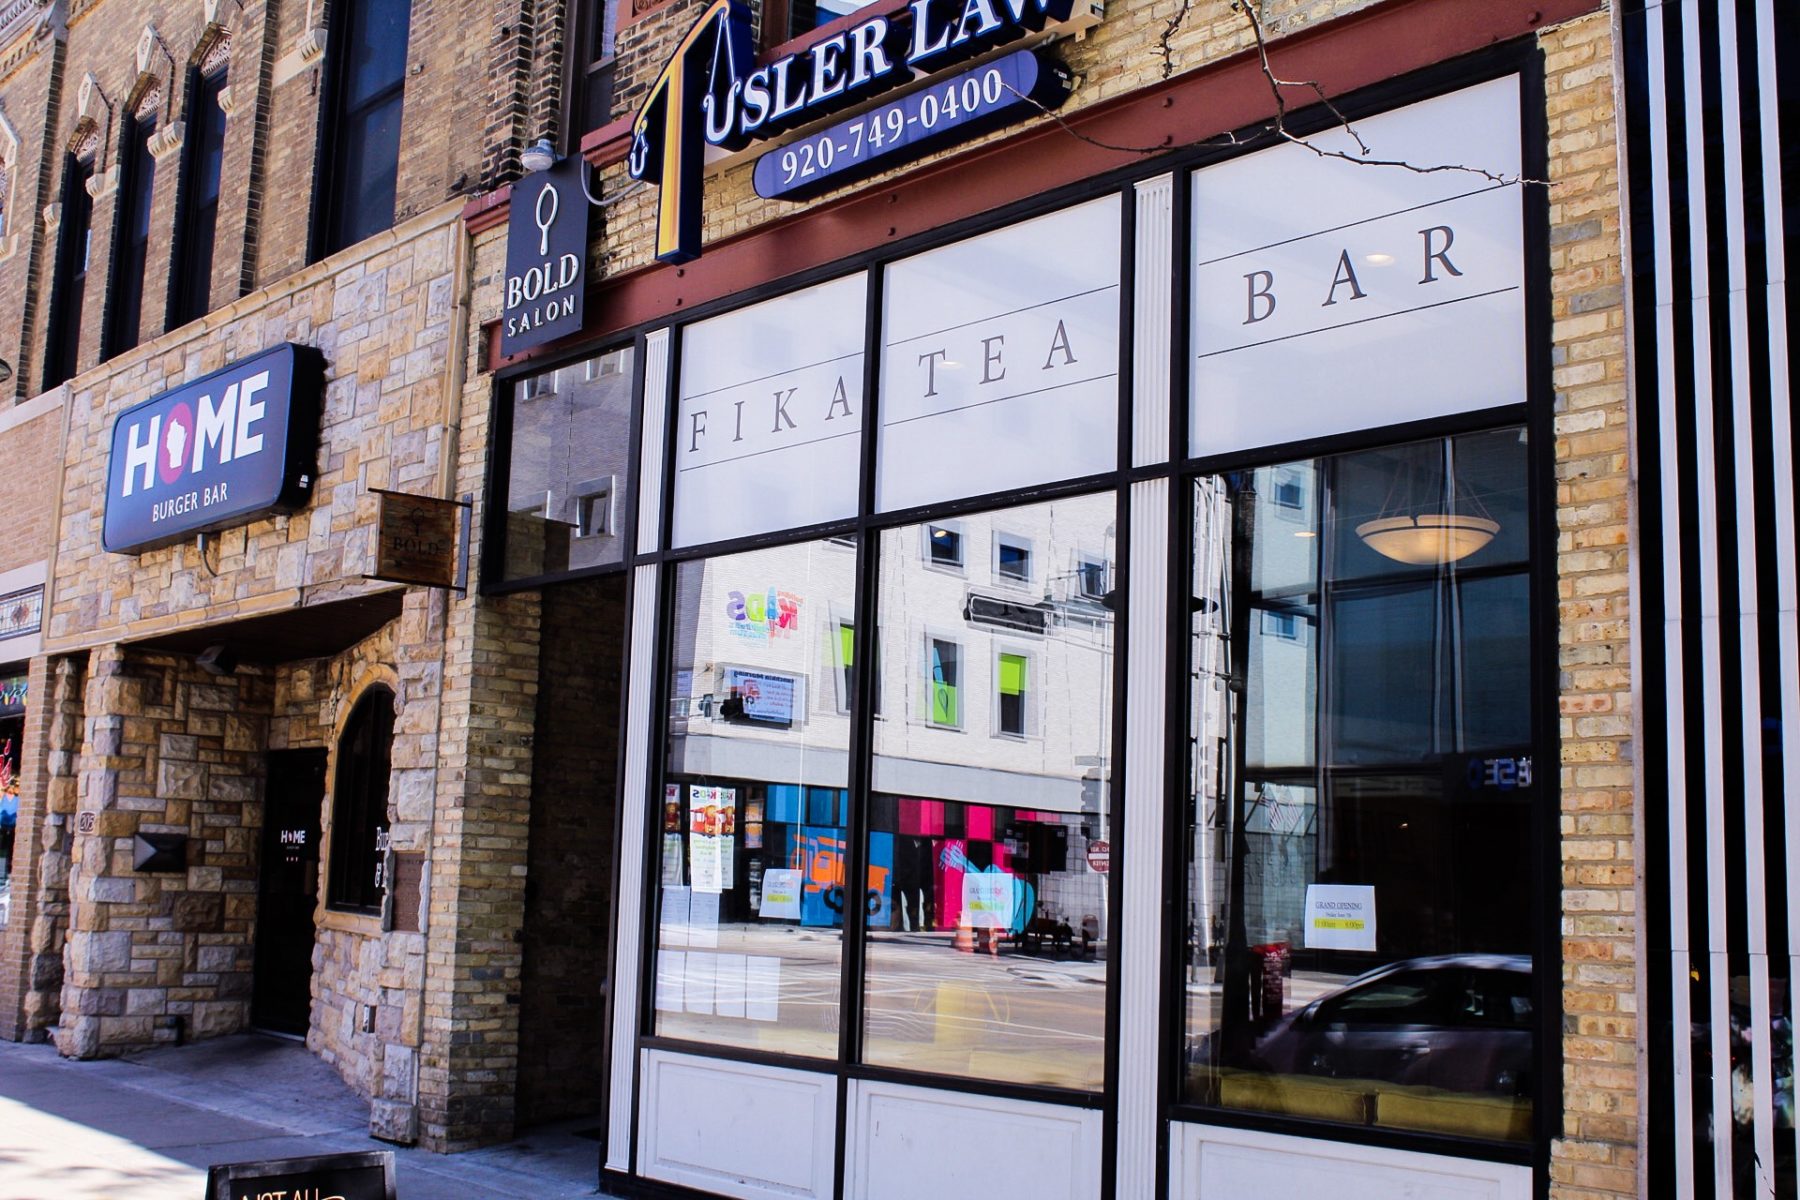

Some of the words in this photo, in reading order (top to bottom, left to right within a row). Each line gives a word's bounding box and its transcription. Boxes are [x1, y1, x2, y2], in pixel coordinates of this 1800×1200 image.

[781, 68, 1002, 185] 920-749-0400
[507, 253, 580, 309] BOLD
[507, 294, 575, 338] SALON
[688, 375, 854, 453] FIKA
[918, 318, 1078, 398] TEA
[1242, 225, 1464, 326] BAR
[122, 370, 270, 498] HOME
[152, 491, 199, 523] BURGER
[203, 482, 228, 507] BAR
